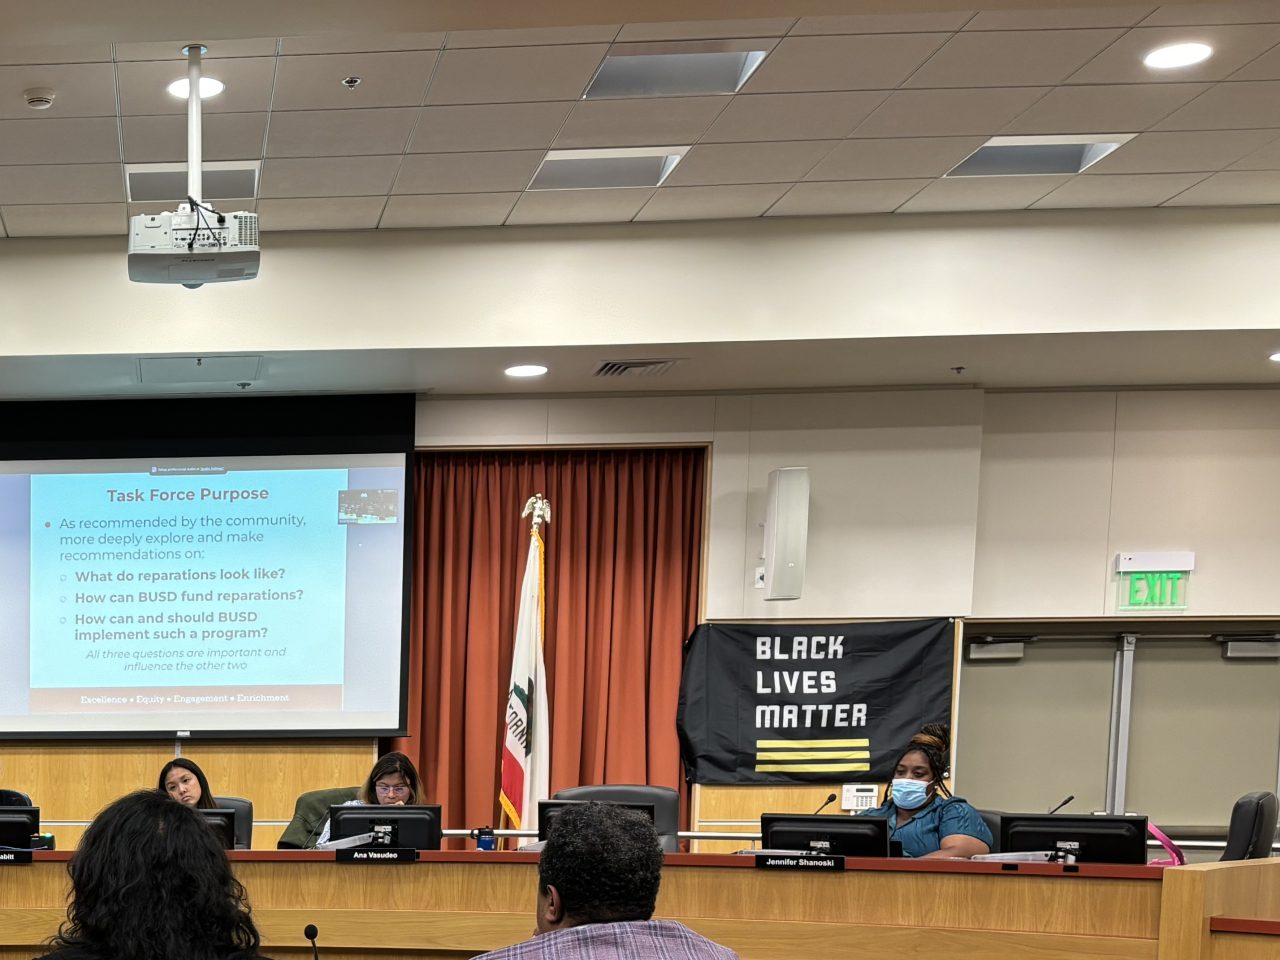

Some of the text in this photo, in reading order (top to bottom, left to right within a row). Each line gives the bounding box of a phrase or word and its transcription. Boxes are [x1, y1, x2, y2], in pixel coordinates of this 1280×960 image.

[107, 487, 269, 503] Task Force Purpose
[59, 513, 307, 530] As recommended by the community,
[60, 531, 264, 547] more deeply explore and make
[60, 548, 182, 561] recommendations
[75, 567, 286, 583] What do reparations look like?
[75, 588, 304, 604] How can BUSD fund reparations?
[1129, 572, 1183, 606] EXIT
[75, 611, 258, 625] How can and should BUSD
[74, 627, 268, 643] implement such a program?
[85, 647, 287, 660] All three questions are important and
[756, 635, 844, 660] BLACK
[123, 661, 248, 671] influence the other two
[756, 670, 837, 694] LIVES
[80, 693, 290, 705] Excellence Equity Engagement Enrichment
[755, 703, 867, 729] MATTER
[353, 851, 398, 859] Ana Vasudeo
[766, 858, 835, 867] Jennifer Shanoski
